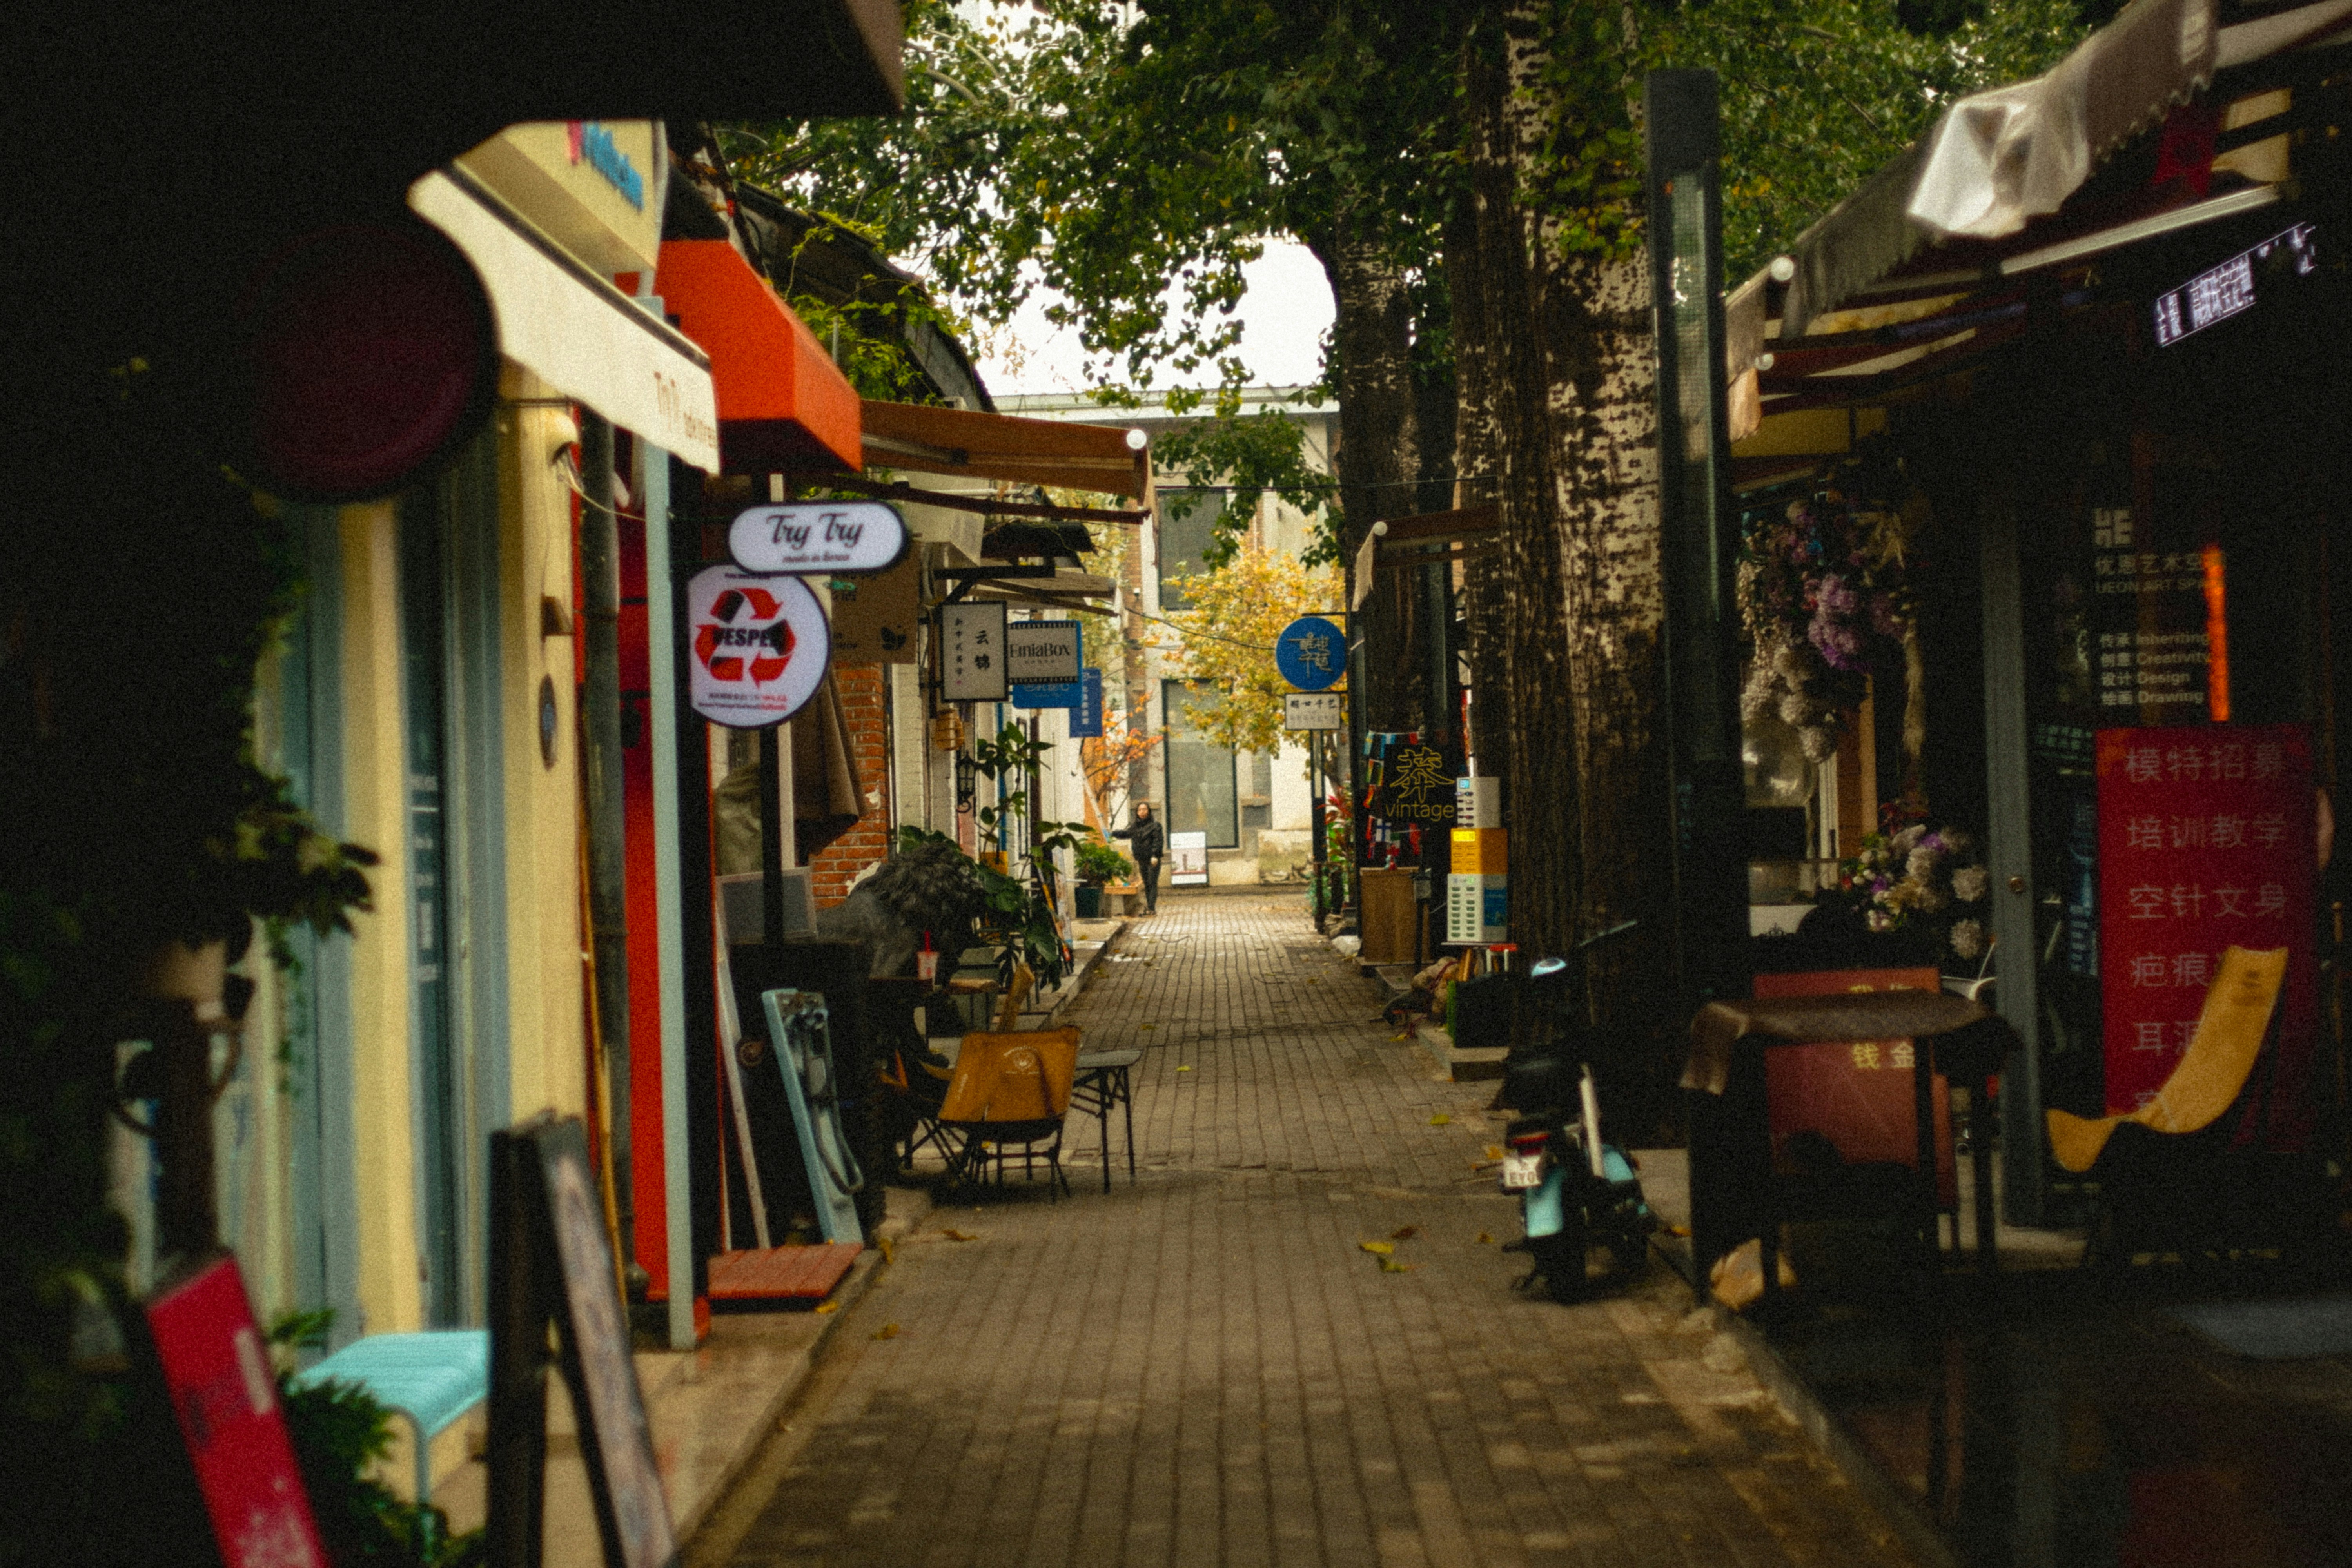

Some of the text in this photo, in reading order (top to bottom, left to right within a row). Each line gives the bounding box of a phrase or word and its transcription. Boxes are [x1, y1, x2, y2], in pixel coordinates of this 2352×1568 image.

[766, 512, 864, 550] Try Try
[2136, 651, 2211, 665] Creativity
[2137, 670, 2190, 686] Design
[2137, 689, 2204, 704] Drawing
[2126, 743, 2286, 782] 模特招募
[1386, 799, 1455, 822] vintage
[2127, 812, 2287, 849] 培训教学
[2129, 881, 2288, 920] 空针文身
[2130, 951, 2223, 987] 疤痕
